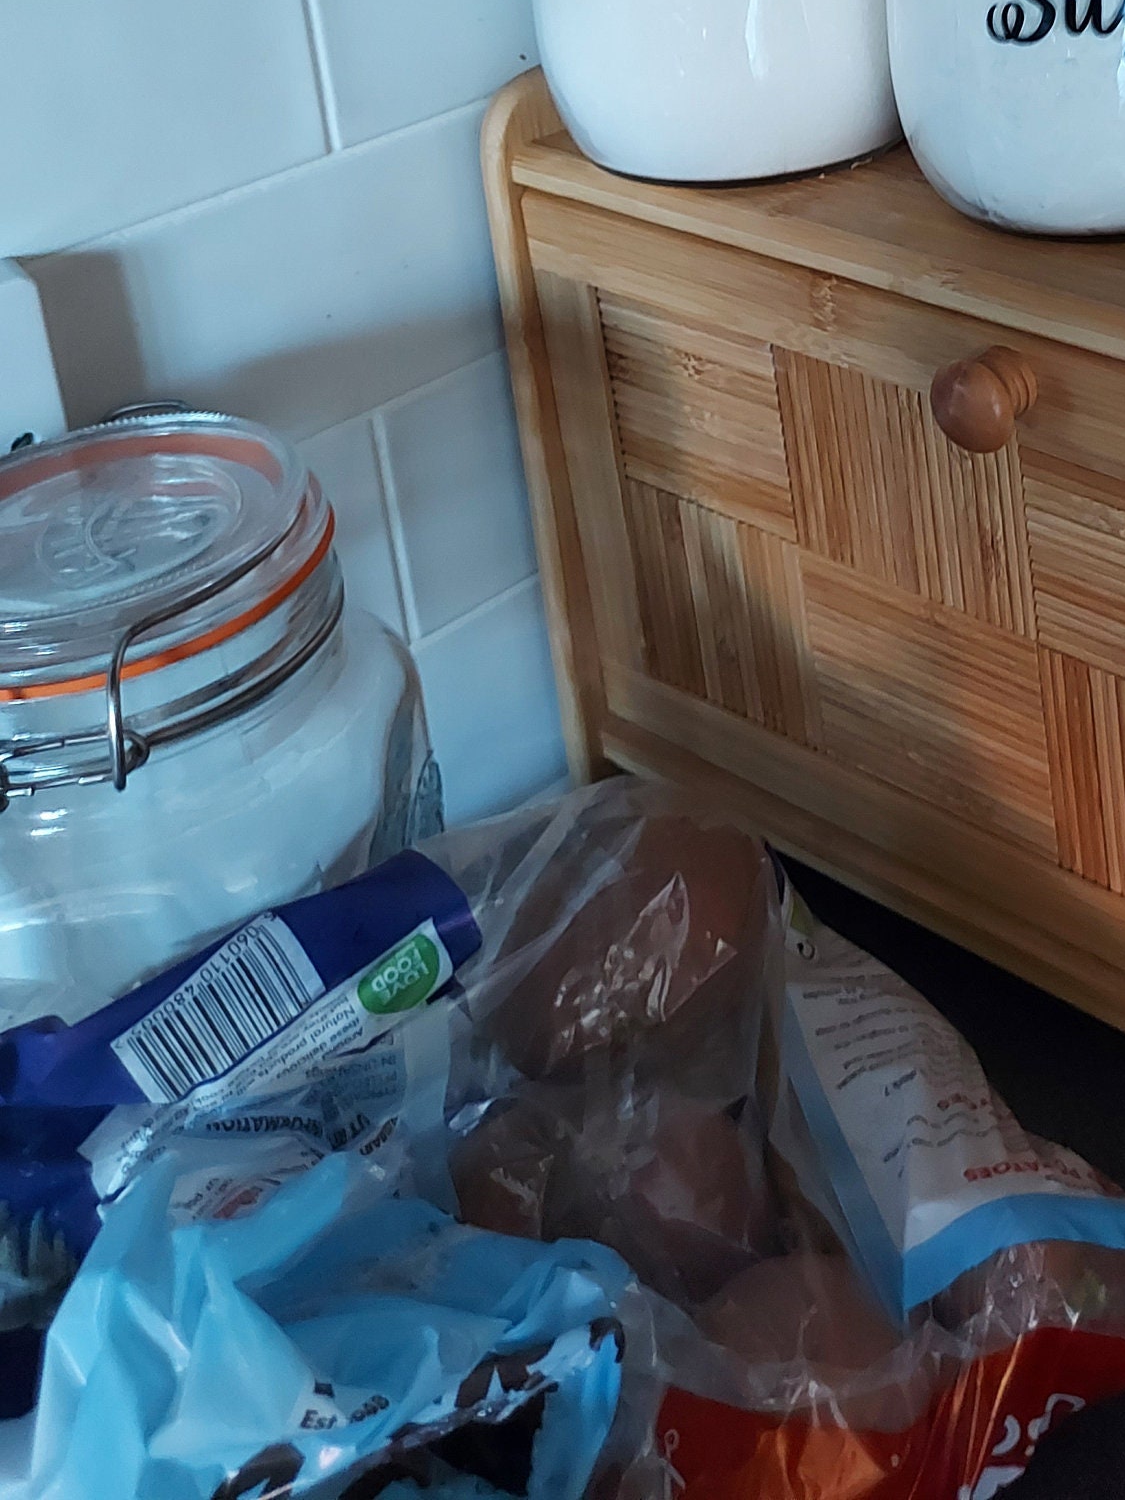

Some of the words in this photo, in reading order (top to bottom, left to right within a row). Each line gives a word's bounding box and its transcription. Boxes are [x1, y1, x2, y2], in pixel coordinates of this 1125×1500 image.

[367, 947, 423, 994] FOOD
[307, 1002, 356, 1044] Natural
[256, 1036, 309, 1079] products
